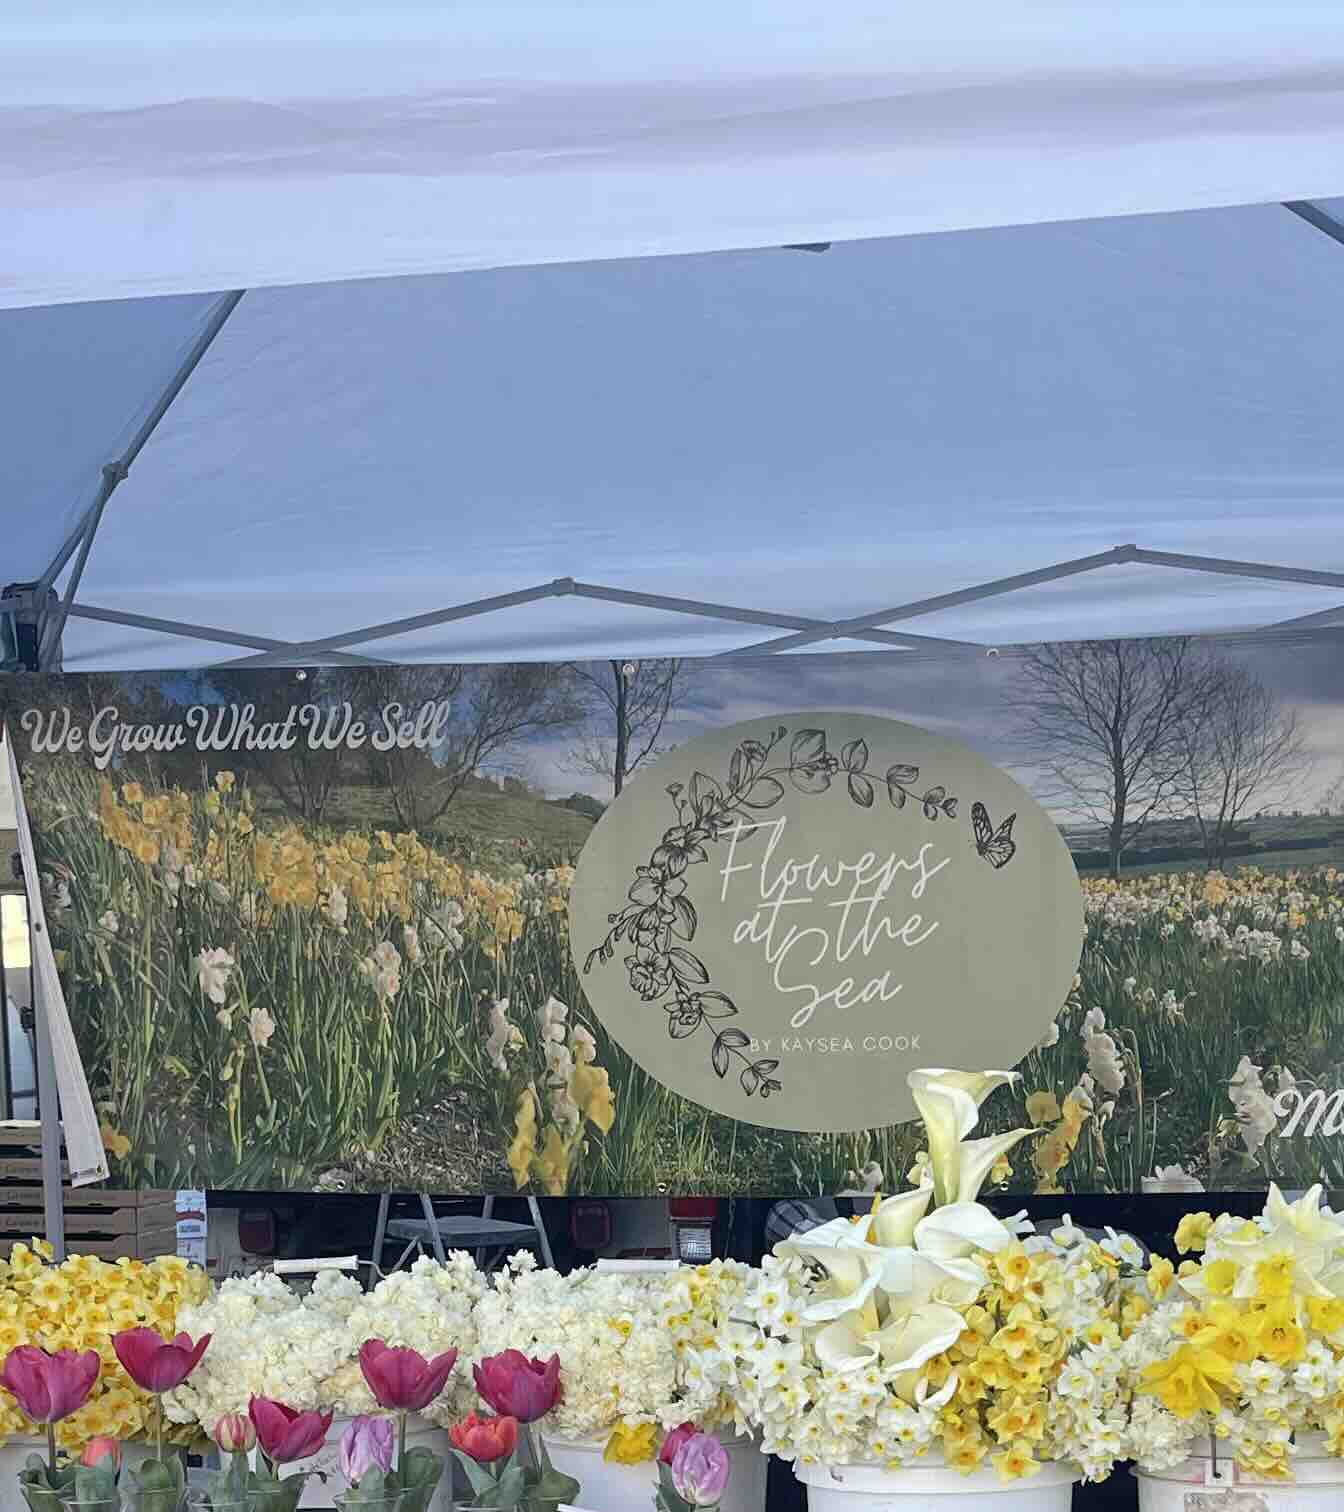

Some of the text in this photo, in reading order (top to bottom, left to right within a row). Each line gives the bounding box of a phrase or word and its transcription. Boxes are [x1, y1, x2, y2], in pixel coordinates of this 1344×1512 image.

[21, 700, 449, 770] We Grow What We Sell
[718, 815, 952, 902] Flowers
[733, 880, 940, 963] at the
[774, 928, 903, 1028] Sea
[750, 1035, 921, 1052] BY KAYSEA COOK
